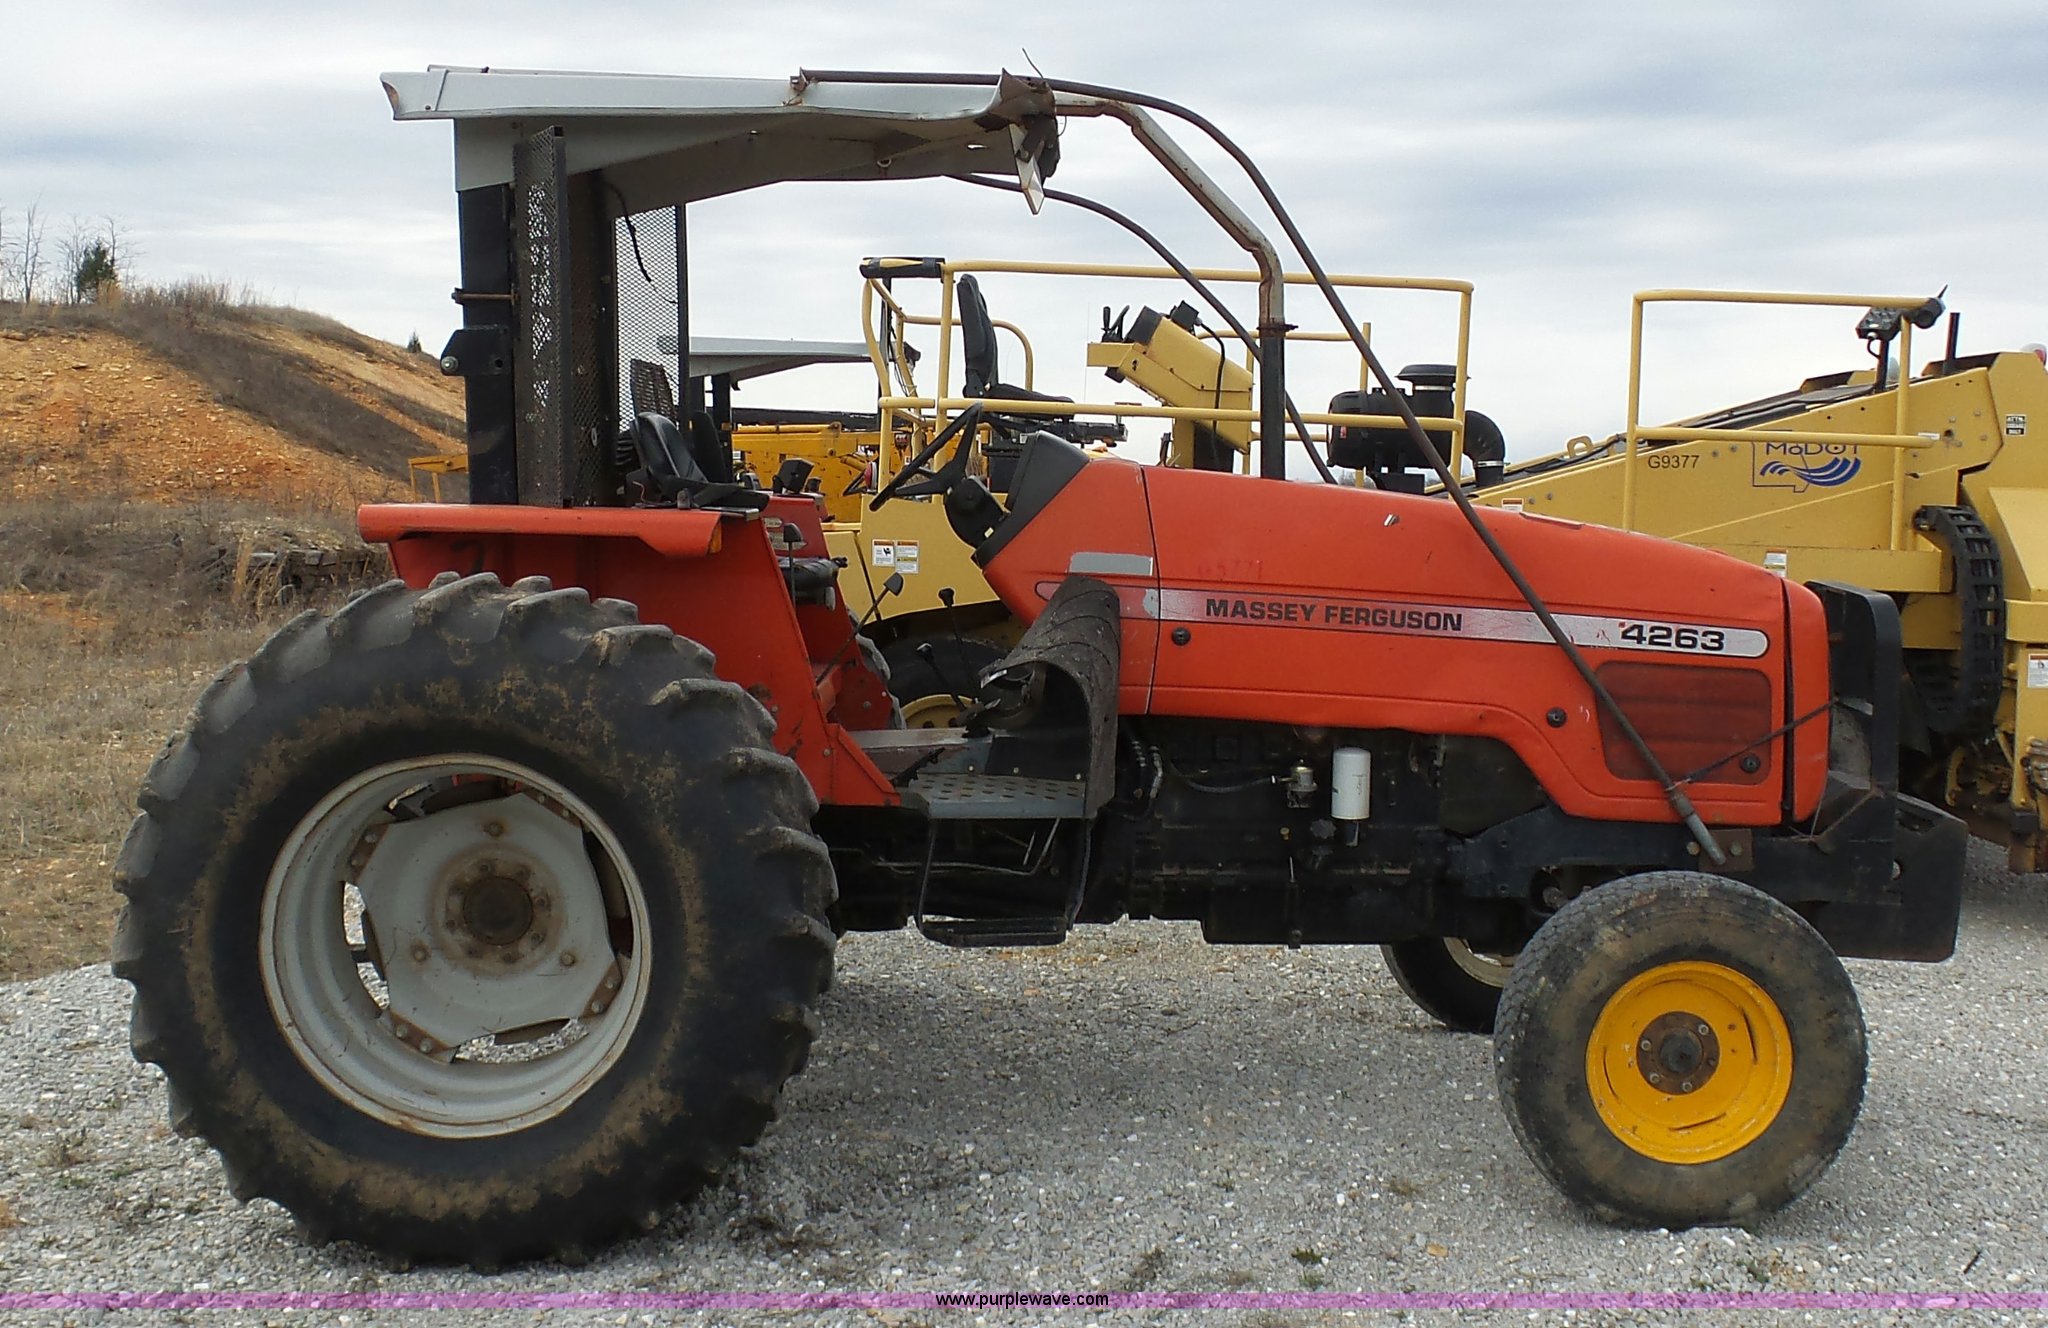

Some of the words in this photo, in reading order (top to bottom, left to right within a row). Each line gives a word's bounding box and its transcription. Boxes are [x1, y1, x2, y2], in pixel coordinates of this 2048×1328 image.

[1648, 455, 1700, 469] G9377
[1206, 598, 1316, 622] MASSEY
[1325, 605, 1462, 631] FERGUSON
[1621, 624, 1725, 651] 4263
